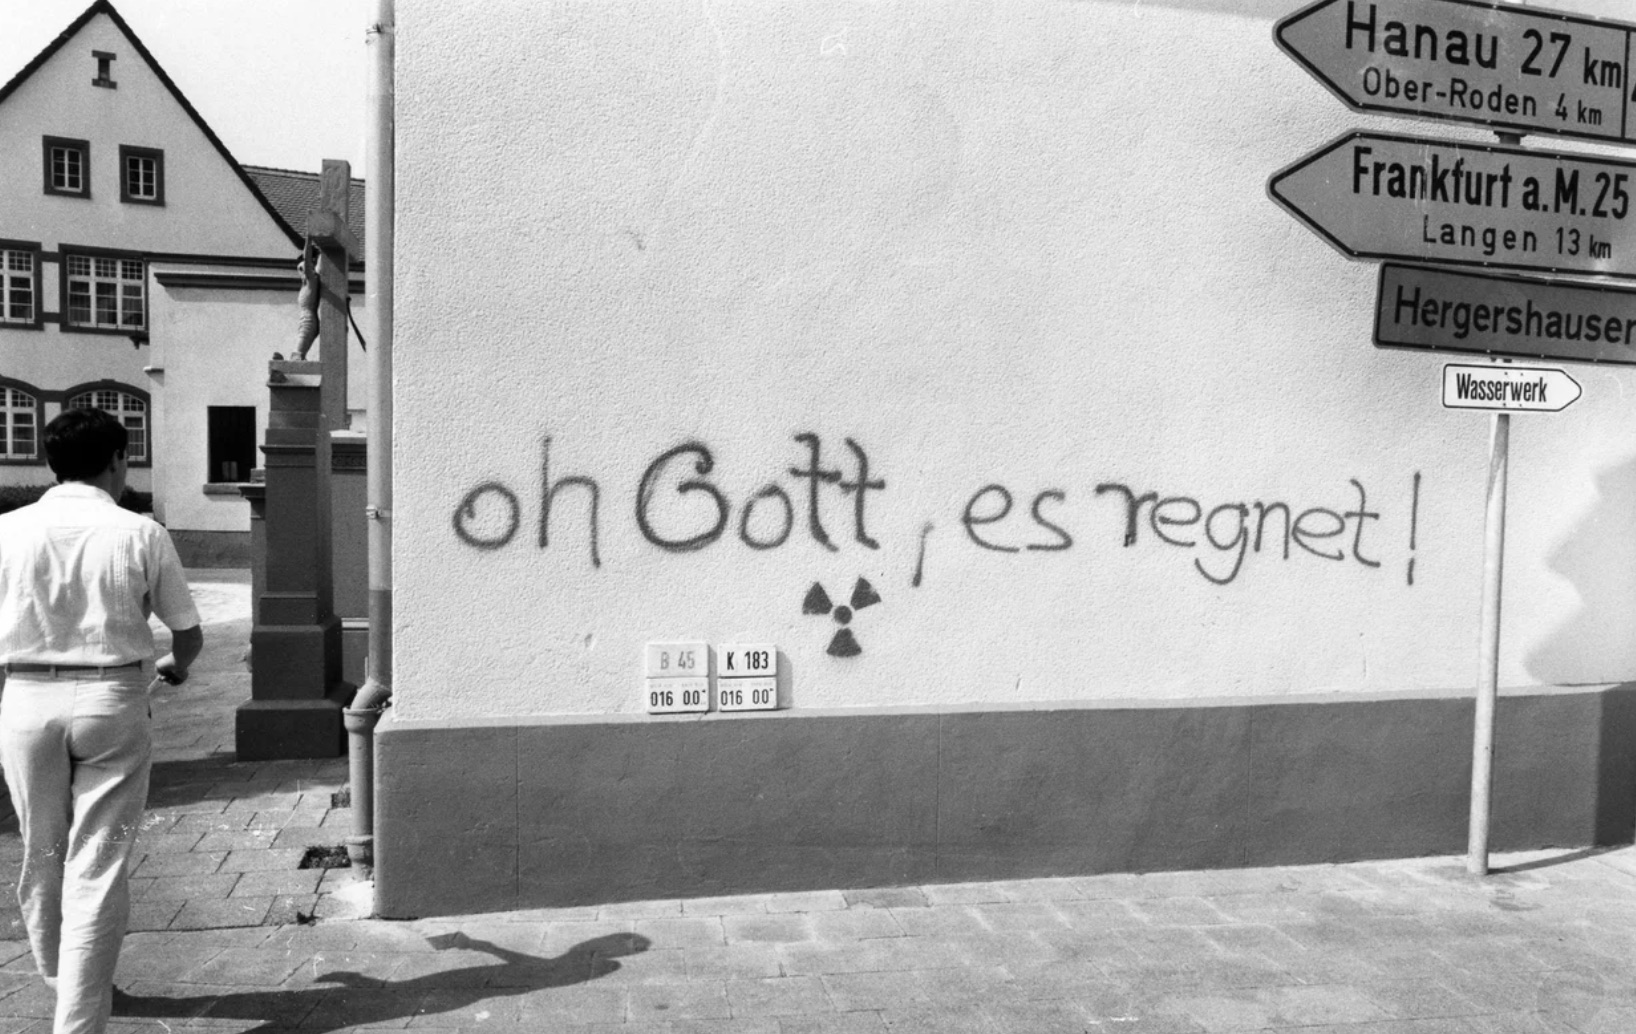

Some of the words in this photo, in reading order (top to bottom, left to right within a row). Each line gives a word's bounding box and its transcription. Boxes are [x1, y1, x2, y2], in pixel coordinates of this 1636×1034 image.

[1345, 0, 1498, 69] Hanau
[1521, 28, 1571, 78] 27
[1583, 46, 1622, 88] km
[1363, 66, 1537, 117] Ober-Roden
[1555, 92, 1568, 121] 4
[1577, 99, 1602, 126] km
[1353, 145, 1512, 208] Frankfurt
[1423, 214, 1537, 256] Langen
[1556, 226, 1580, 256] 13
[1588, 233, 1612, 259] km
[1456, 372, 1548, 403] Wasserwerk
[452, 437, 601, 569] oh
[963, 483, 1073, 553] es
[660, 651, 669, 670] B
[678, 651, 695, 669] 45
[727, 651, 735, 670] K
[744, 650, 769, 670] 183
[650, 690, 673, 707] 016
[720, 689, 743, 706] 016
